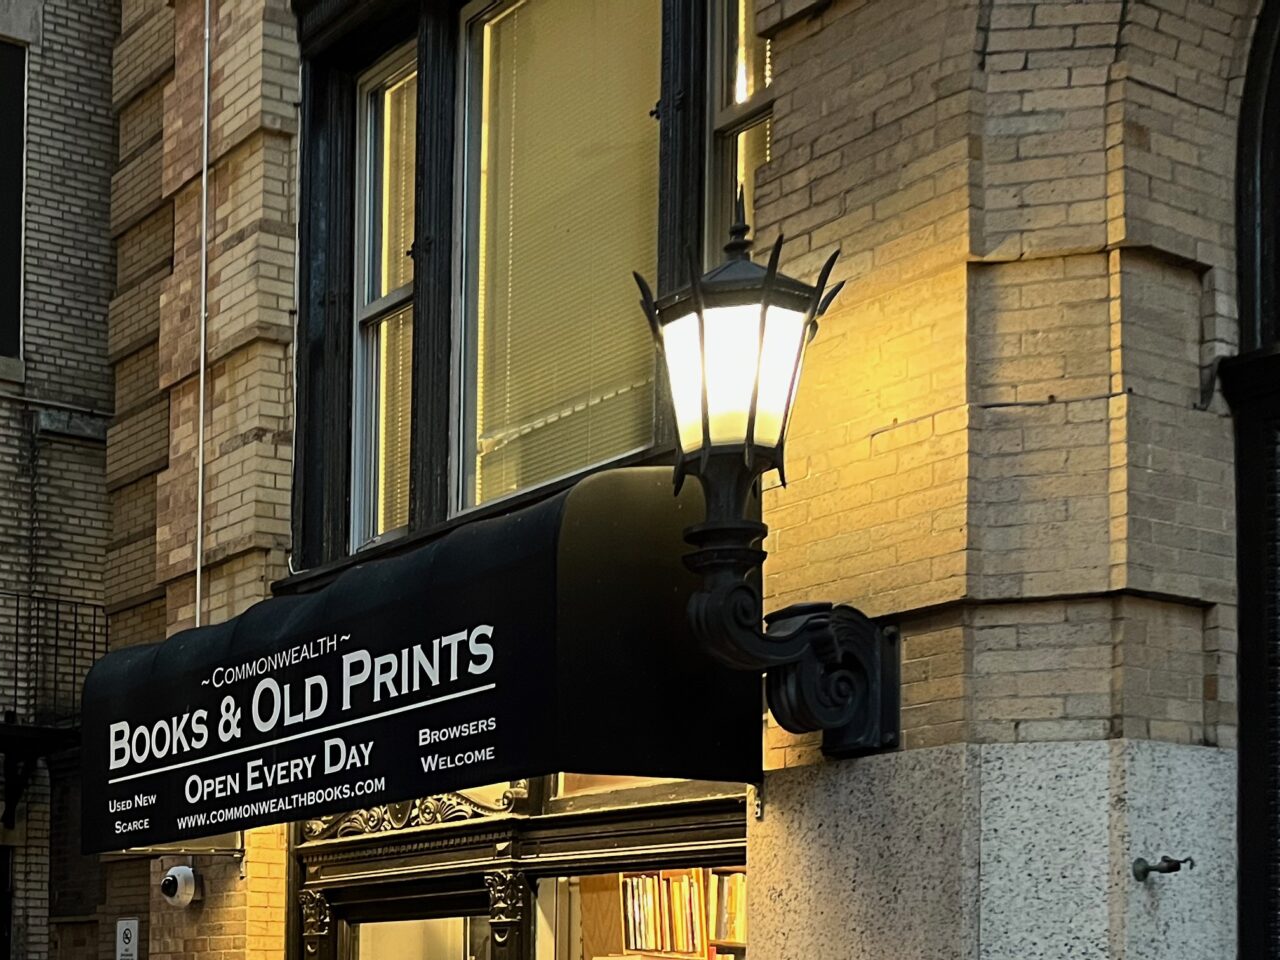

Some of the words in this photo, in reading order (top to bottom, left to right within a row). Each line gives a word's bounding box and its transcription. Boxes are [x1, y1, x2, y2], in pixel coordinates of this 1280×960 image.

[109, 708, 209, 770] BOOKS
[218, 695, 242, 742] &
[251, 674, 329, 733] OLD
[342, 624, 495, 710] PRINTS
[418, 717, 497, 747] BROWSERS
[184, 772, 241, 804] OPEN
[246, 754, 317, 791] EVERY
[324, 737, 375, 775] DAY
[420, 746, 495, 773] WELCOME
[108, 796, 133, 813] USED
[134, 792, 157, 809] NEW
[114, 817, 150, 834] SCARCE
